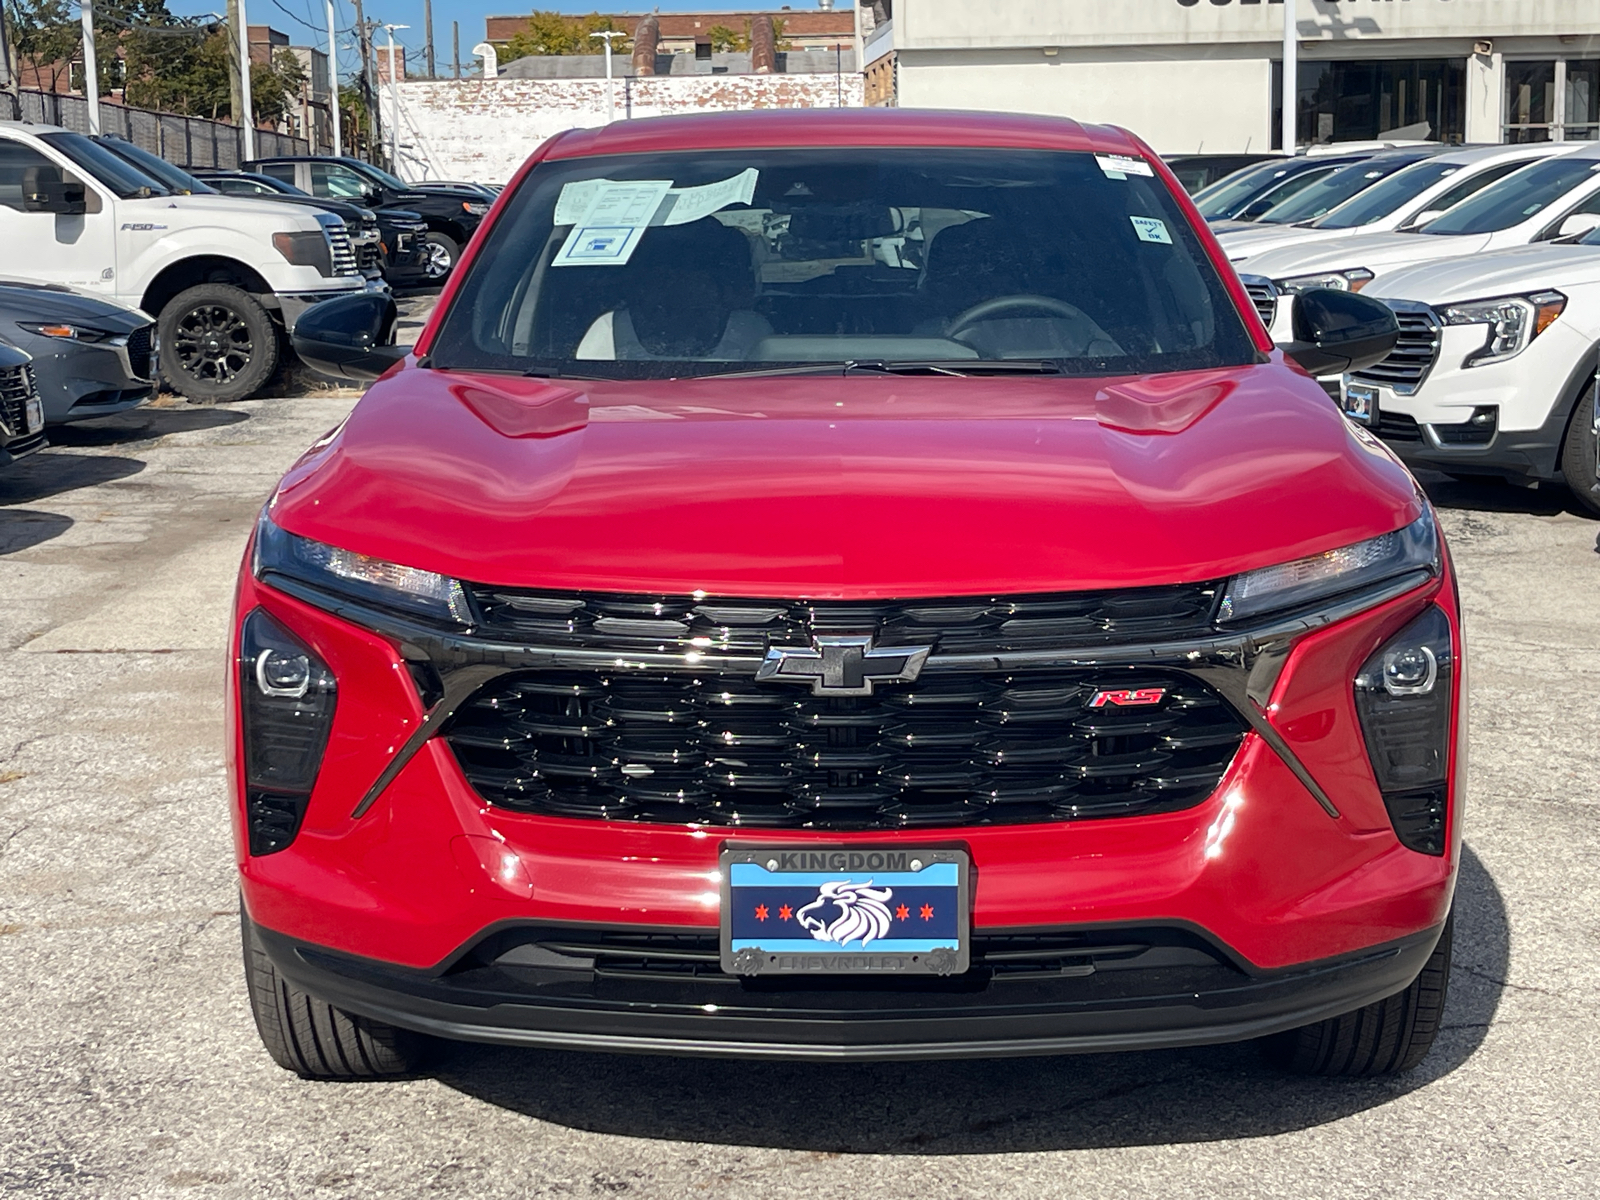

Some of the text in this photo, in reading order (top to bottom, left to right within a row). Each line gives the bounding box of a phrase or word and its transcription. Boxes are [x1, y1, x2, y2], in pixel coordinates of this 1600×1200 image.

[1134, 219, 1162, 228] SAFETY
[1088, 687, 1167, 708] RS
[780, 852, 907, 870] KINGDOM
[778, 955, 910, 970] CHEVROLET
